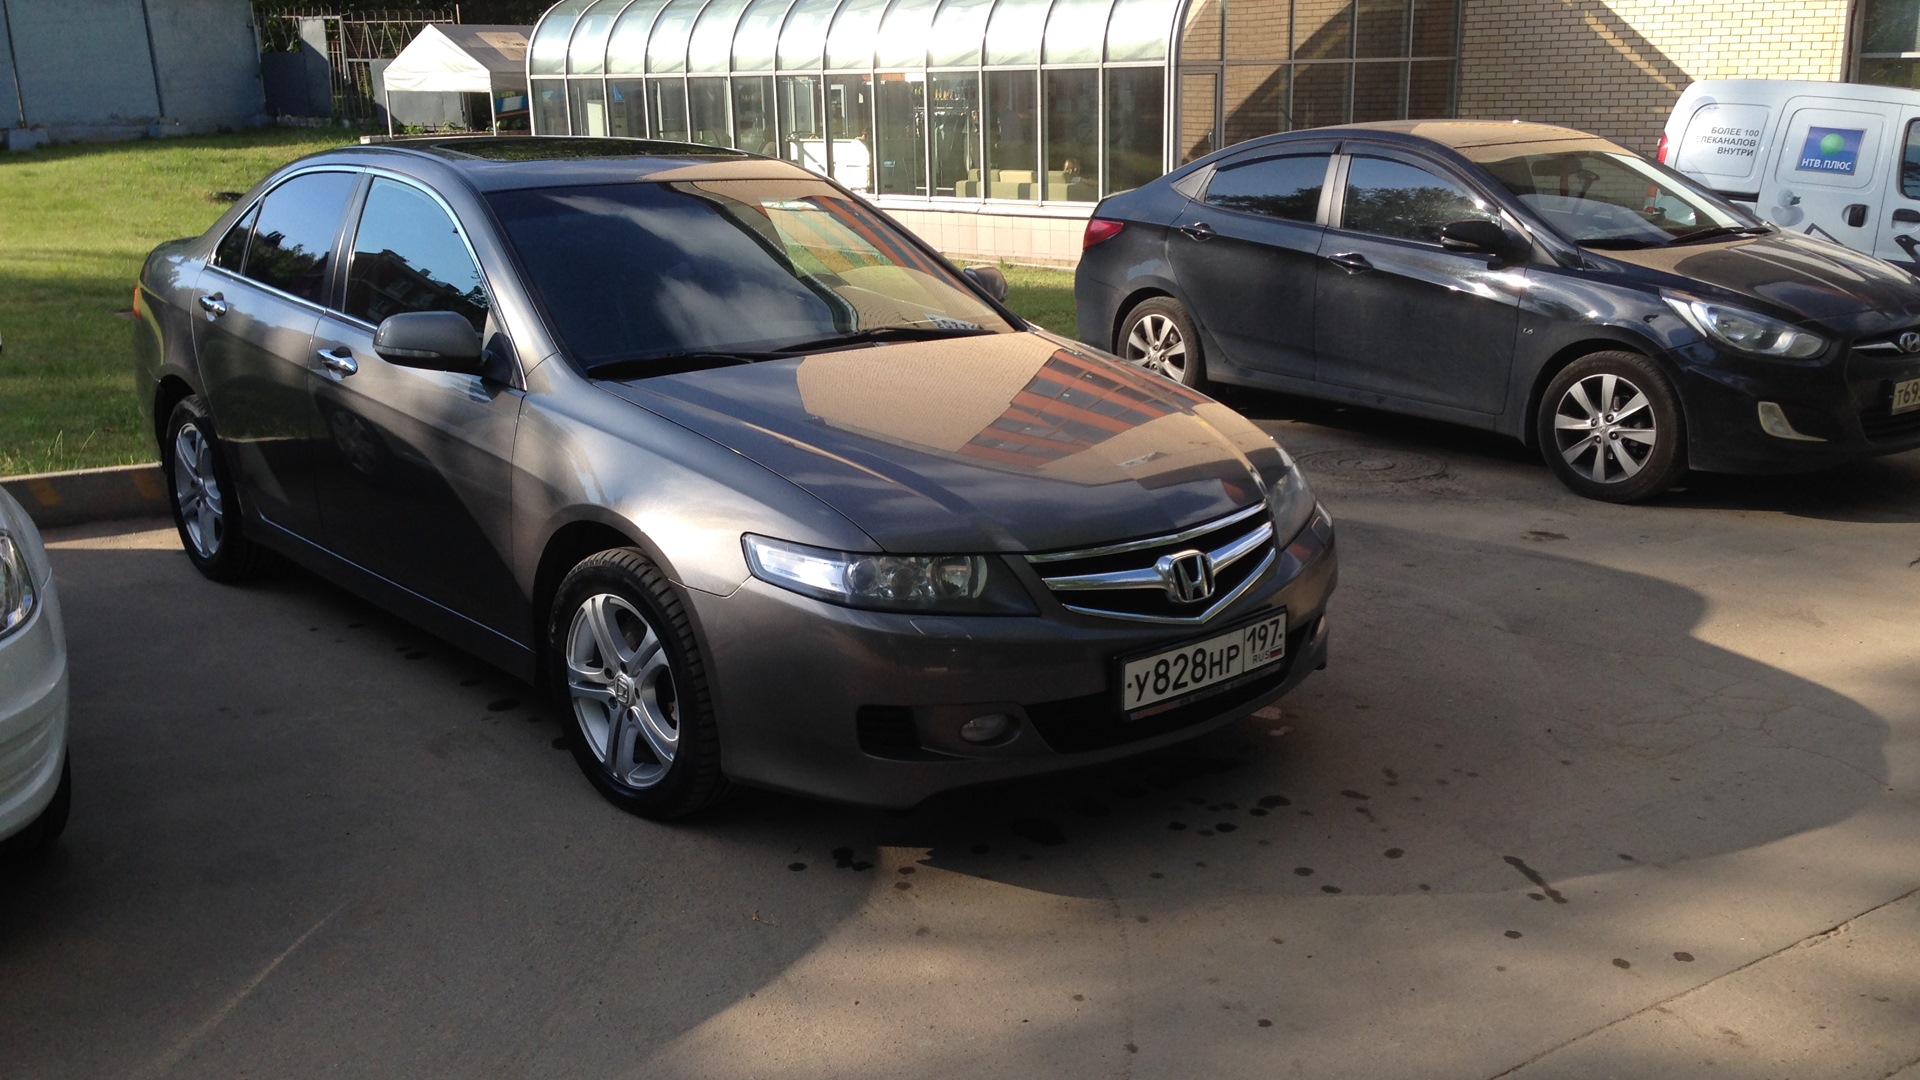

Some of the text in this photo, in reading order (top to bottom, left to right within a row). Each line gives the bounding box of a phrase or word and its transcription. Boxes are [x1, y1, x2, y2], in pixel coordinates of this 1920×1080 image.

[1711, 126, 1760, 137] БОЛЕЕ 100
[1695, 135, 1757, 147] ЕЛЕКАНАЛОВ
[1717, 146, 1754, 157] ВНУТРИ
[1897, 381, 1920, 405] Т69
[1135, 644, 1240, 702] У828НР
[1246, 618, 1280, 654] 197
[1252, 650, 1270, 664] RUS
